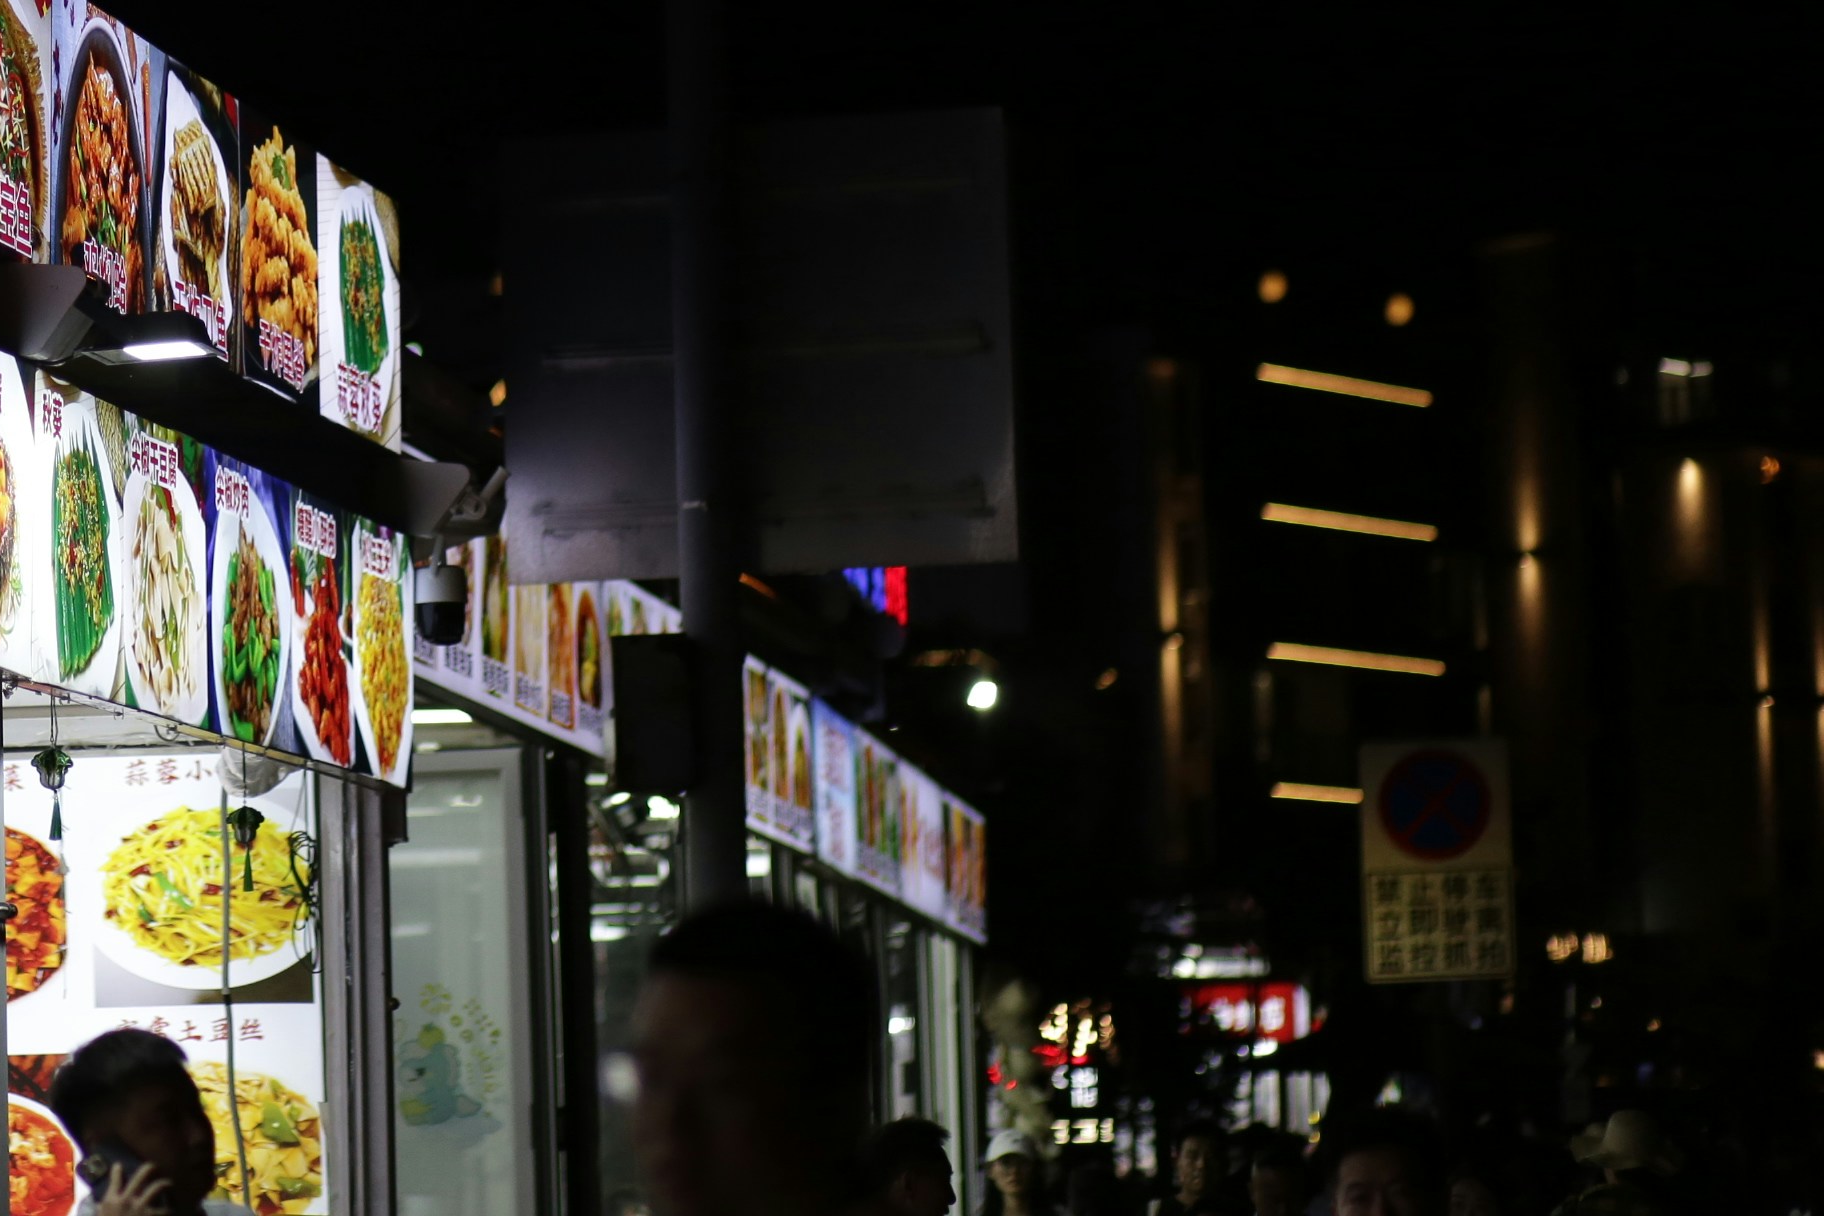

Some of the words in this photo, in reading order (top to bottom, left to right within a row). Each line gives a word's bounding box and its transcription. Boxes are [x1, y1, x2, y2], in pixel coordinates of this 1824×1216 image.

[42, 392, 64, 439] 秋葵
[130, 430, 178, 488] 尖椒干豆腐
[216, 466, 250, 521] 尖椒炒肉
[117, 1015, 264, 1043] 常土豆丝
